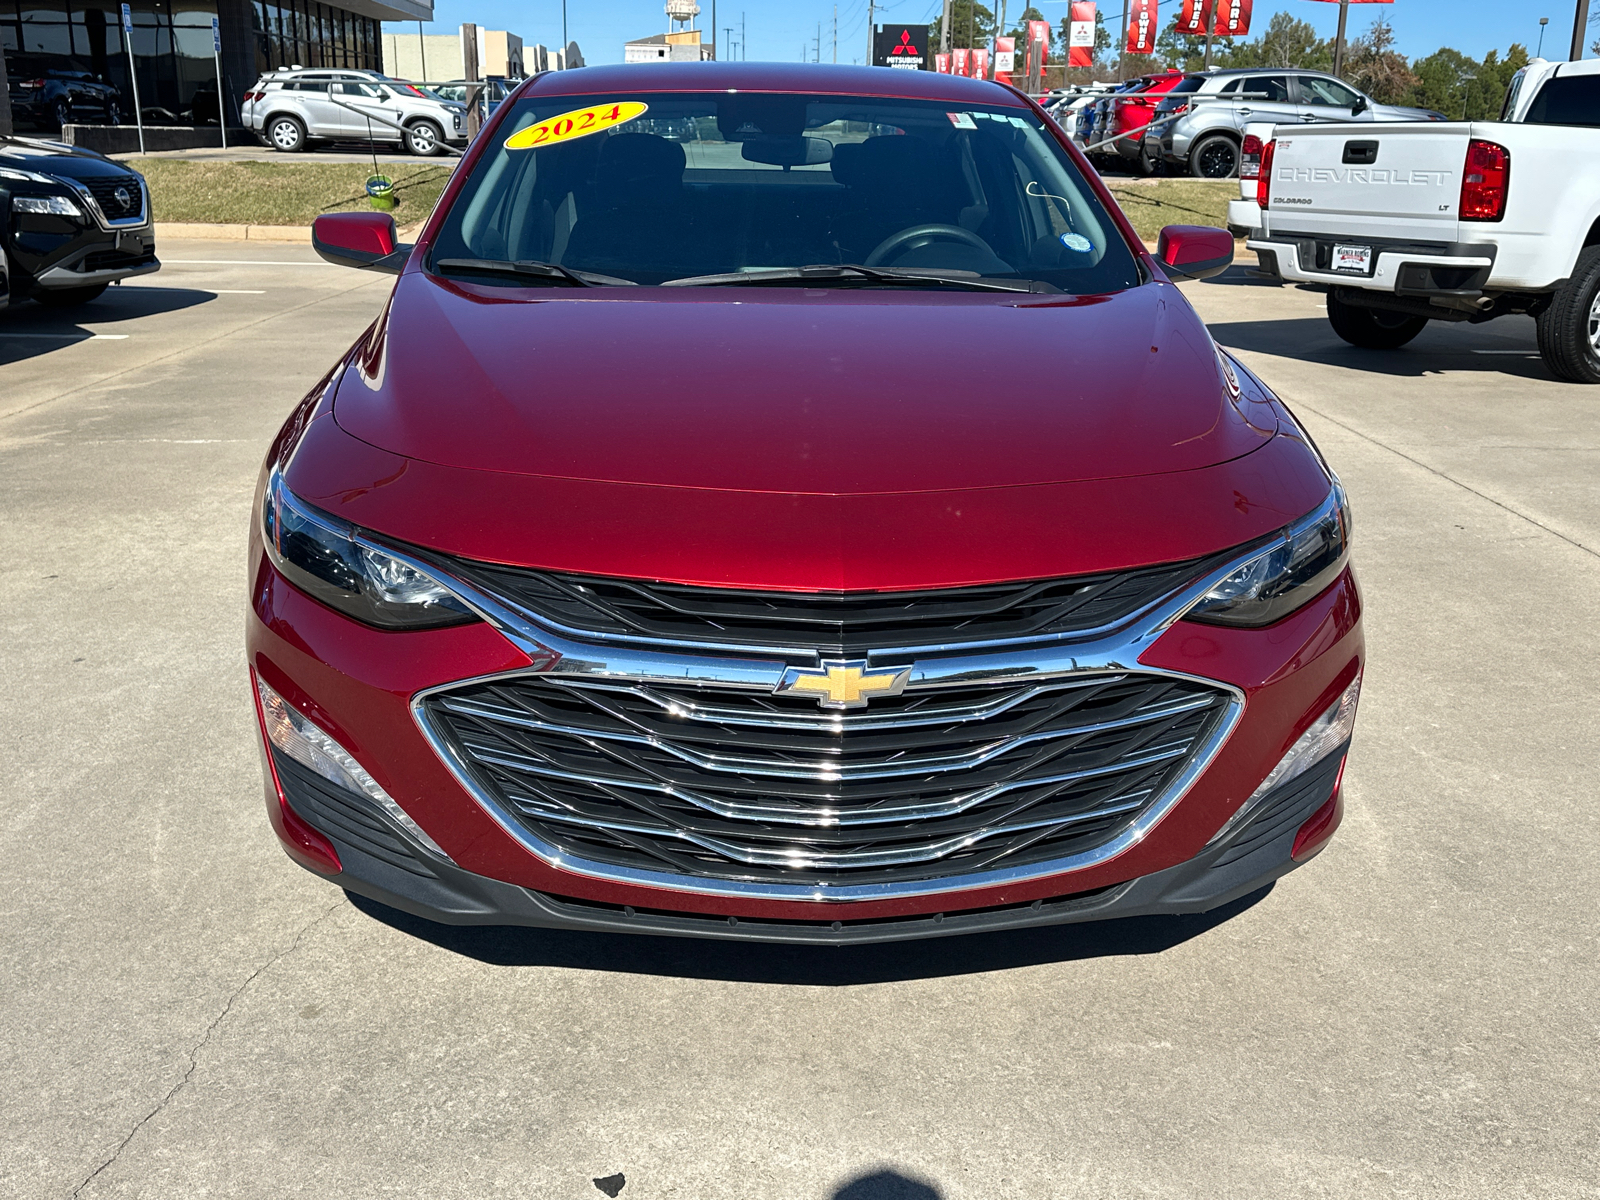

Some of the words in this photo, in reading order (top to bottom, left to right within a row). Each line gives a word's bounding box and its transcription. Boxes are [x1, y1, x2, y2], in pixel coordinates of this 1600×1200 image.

[886, 56, 924, 64] MITSUBISHI
[531, 104, 622, 145] 2024
[1276, 167, 1453, 187] CHEVROLET
[1273, 197, 1313, 205] COLORADO
[1438, 204, 1450, 212] LT
